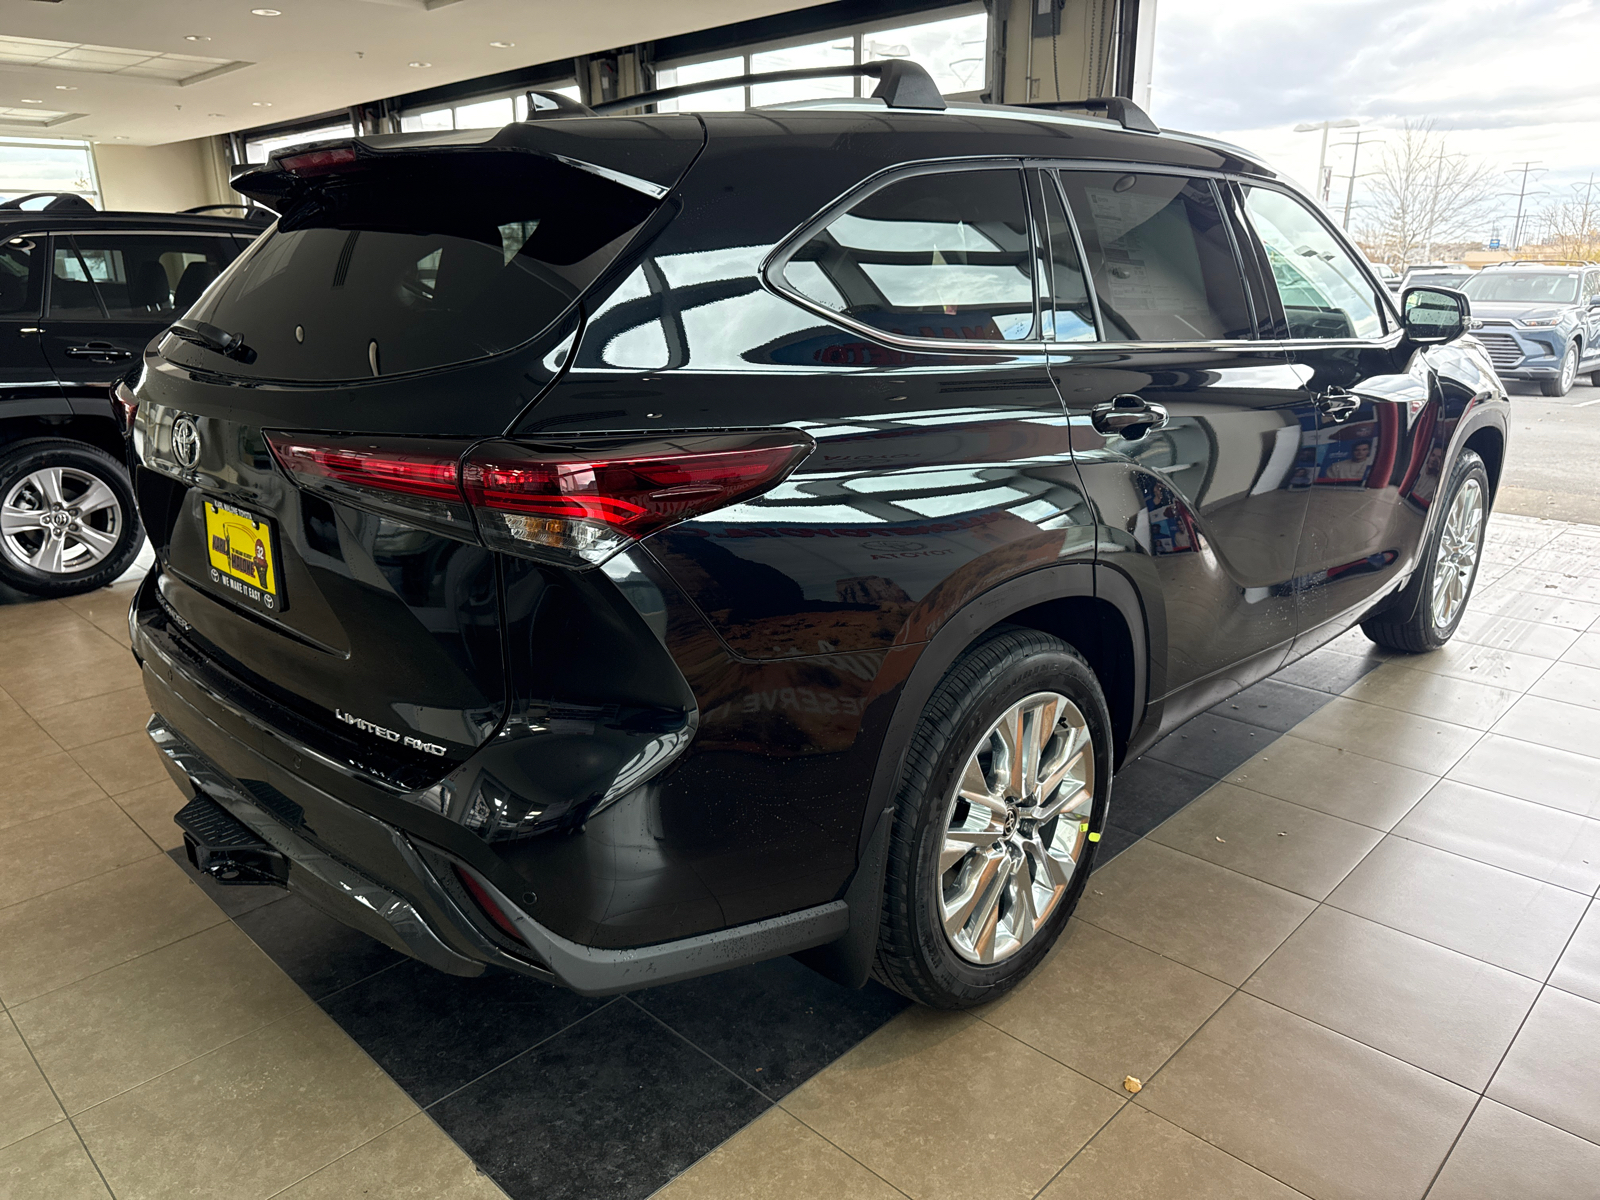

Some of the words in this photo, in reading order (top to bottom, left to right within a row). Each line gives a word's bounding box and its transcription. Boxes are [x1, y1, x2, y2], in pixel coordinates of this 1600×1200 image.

[256, 545, 264, 560] 32
[221, 574, 230, 587] WE
[230, 577, 243, 594] MAKE
[242, 583, 248, 596] IT
[248, 586, 261, 602] EASY
[335, 708, 401, 743] LIMITED
[403, 736, 447, 757] AWD
